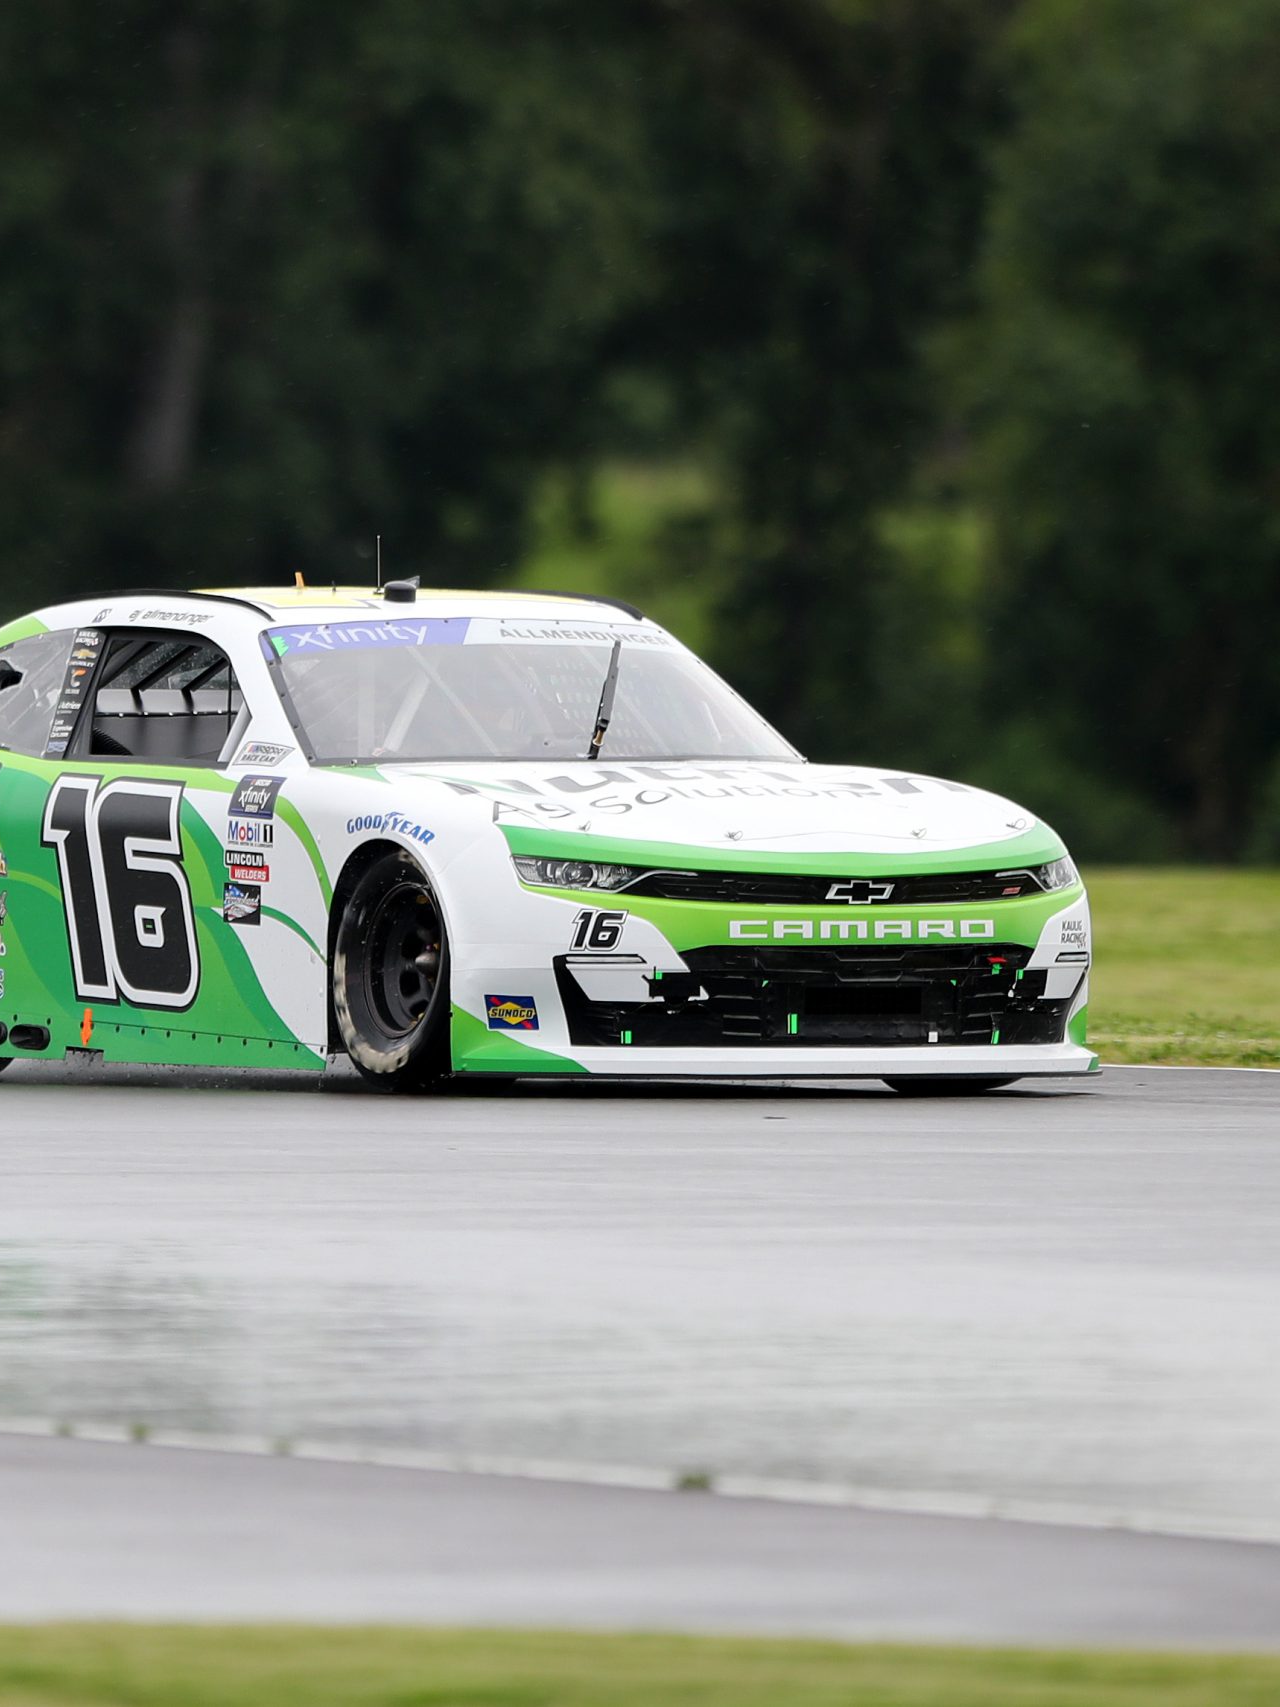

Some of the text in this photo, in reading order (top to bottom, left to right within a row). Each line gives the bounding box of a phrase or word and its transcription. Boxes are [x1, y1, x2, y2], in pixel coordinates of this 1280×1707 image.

[290, 624, 428, 650] xfinity
[499, 628, 671, 646] ALLMENDINGER
[238, 786, 271, 809] xfinity
[492, 801, 576, 822] Ag
[228, 820, 273, 843] Mobil 1
[346, 812, 435, 845] GOODYEAR
[226, 852, 263, 867] LINCOLN
[234, 868, 266, 879] WELDERS
[40, 772, 201, 1013] 16
[570, 909, 629, 951] 16
[728, 919, 994, 939] CAMARO
[490, 1008, 535, 1019] SUNOCO
